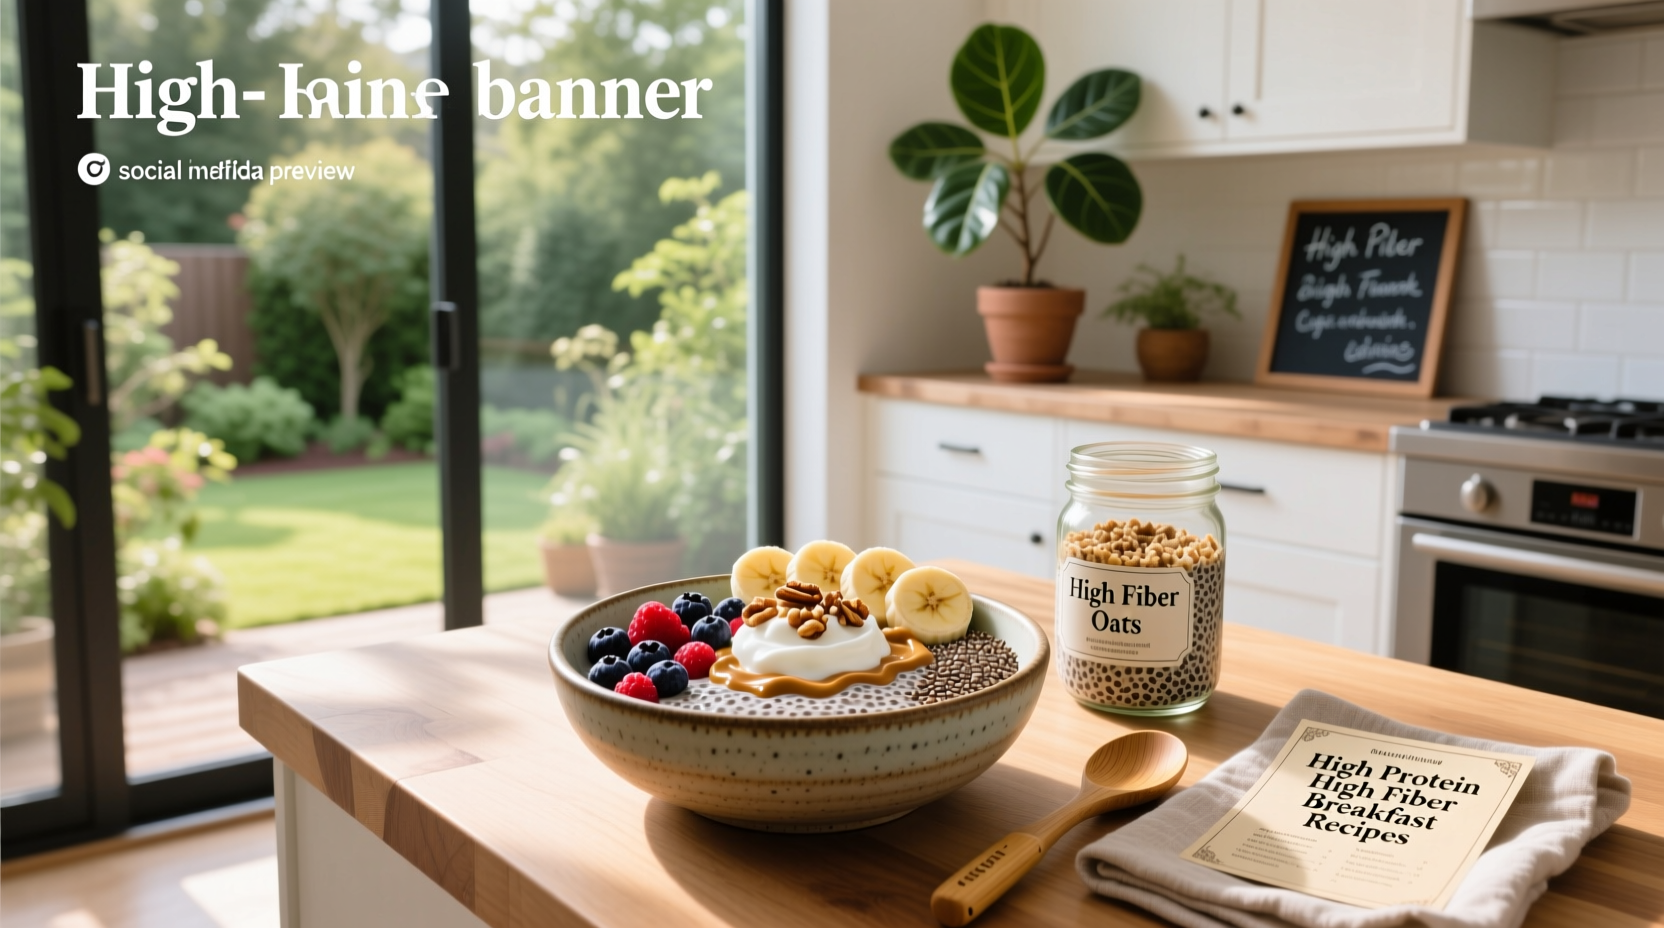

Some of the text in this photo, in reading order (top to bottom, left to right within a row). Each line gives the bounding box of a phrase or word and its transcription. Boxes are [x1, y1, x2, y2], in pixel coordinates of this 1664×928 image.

[1304, 226, 1358, 272] High
[1069, 576, 1180, 608] High Fiber
[1091, 609, 1142, 634] Oats
[1306, 752, 1373, 779] High
[1379, 764, 1480, 796] Protein
[1307, 772, 1458, 812] High Fiber
[1302, 791, 1438, 830] Breakfast
[1303, 812, 1410, 845] Recipes
